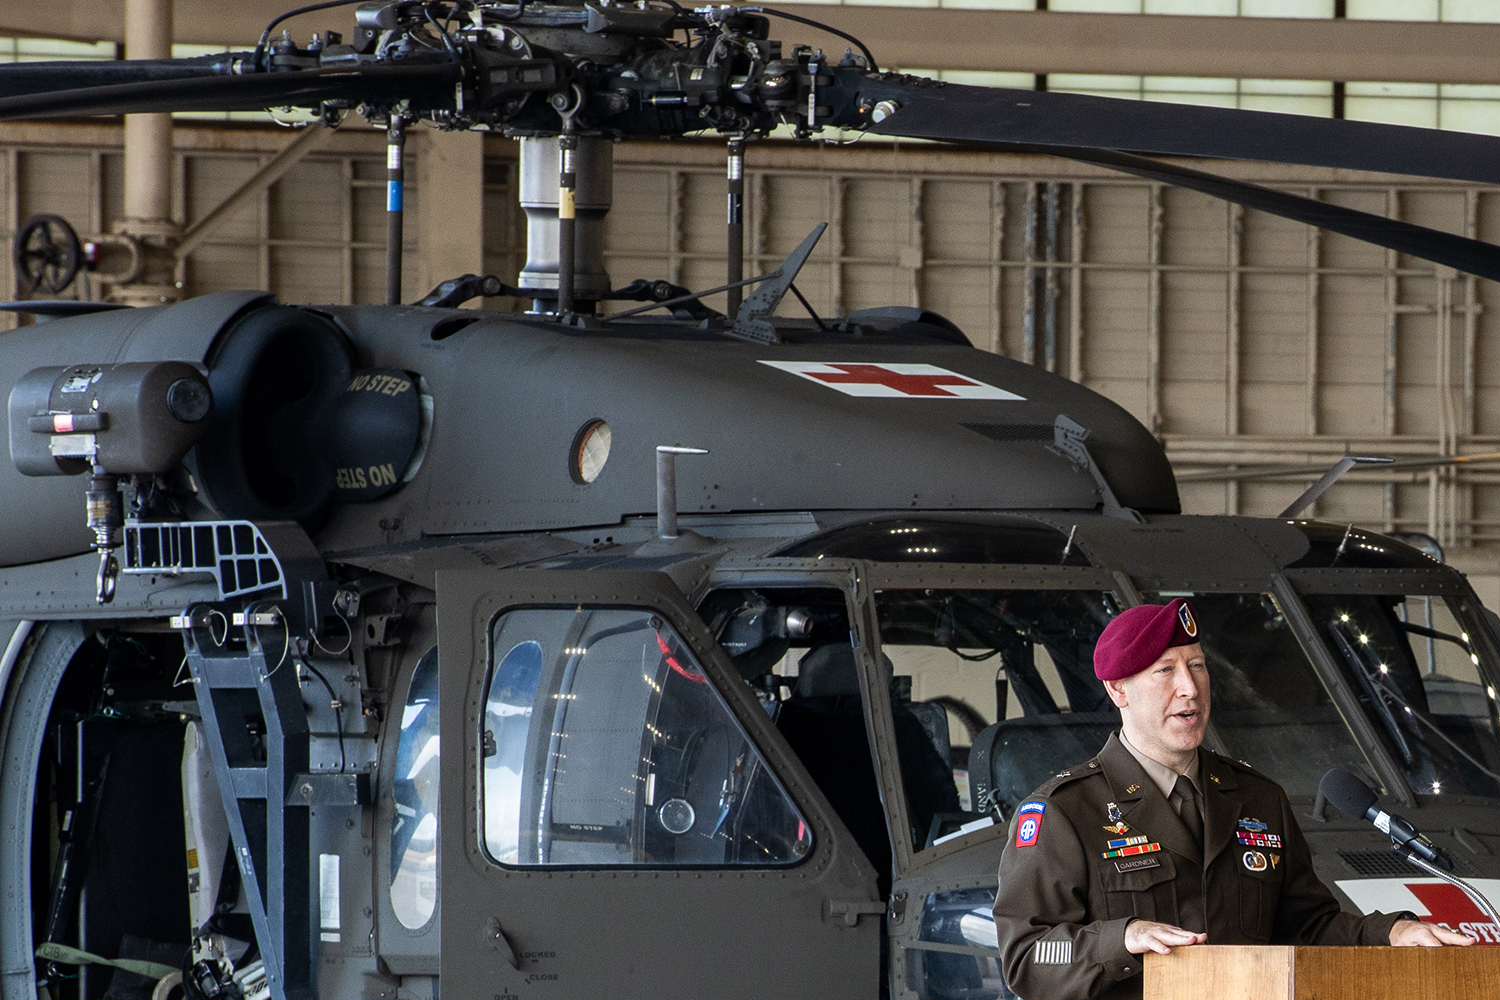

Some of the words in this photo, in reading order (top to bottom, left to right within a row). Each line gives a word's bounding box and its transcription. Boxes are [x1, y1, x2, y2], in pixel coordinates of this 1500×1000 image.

[347, 375, 371, 391] NO
[366, 375, 411, 397] STEP
[369, 463, 397, 487] NO
[1119, 857, 1156, 870] GARDNER
